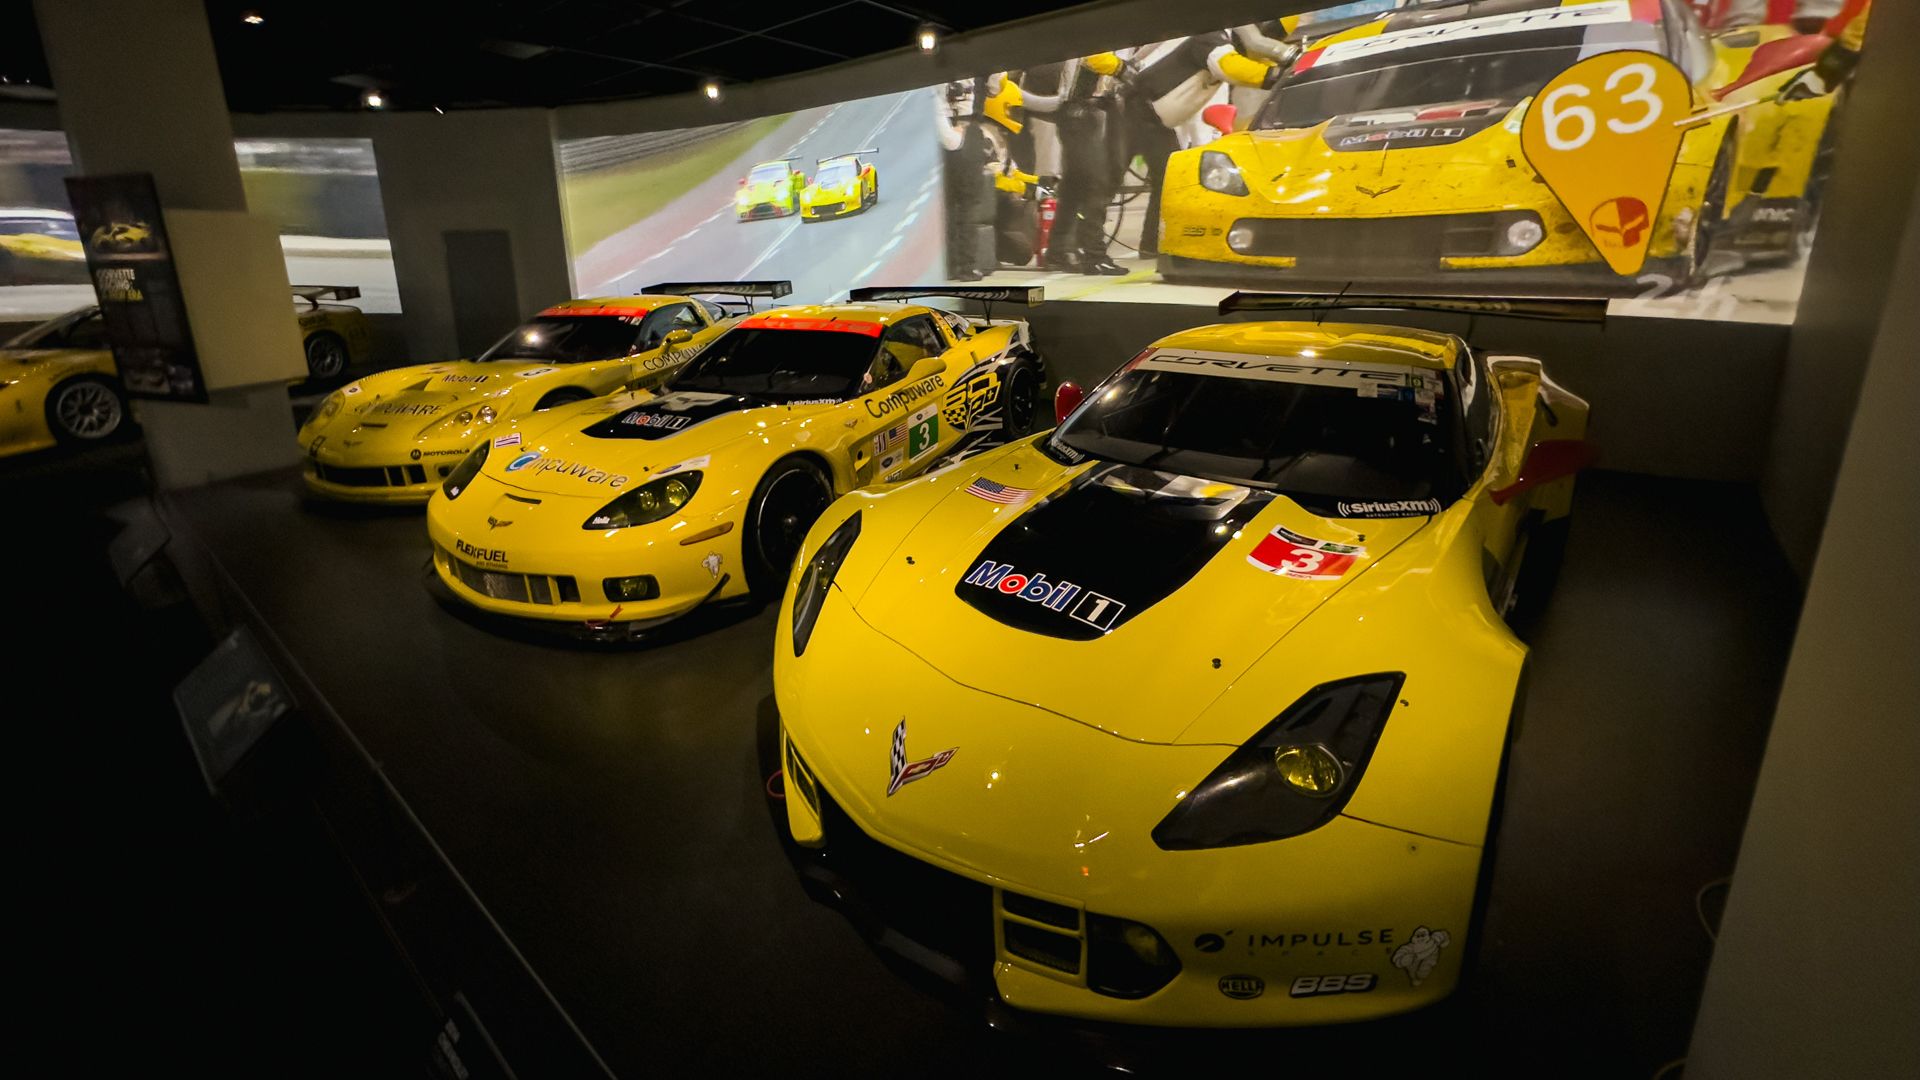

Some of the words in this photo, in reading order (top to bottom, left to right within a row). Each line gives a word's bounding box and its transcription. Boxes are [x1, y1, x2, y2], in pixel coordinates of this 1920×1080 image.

[1541, 62, 1664, 151] 63
[1150, 354, 1404, 381] CORVETTE
[864, 375, 944, 419] Compuware
[621, 411, 673, 428] Mobil
[919, 422, 930, 450] 3
[423, 449, 471, 457] MOTOROLA
[456, 538, 509, 563] FLEXFUEL
[1280, 548, 1324, 573] 3
[965, 560, 1081, 612] Mobil
[1248, 929, 1393, 947] IMPULSE
[1291, 974, 1372, 996] BBS
